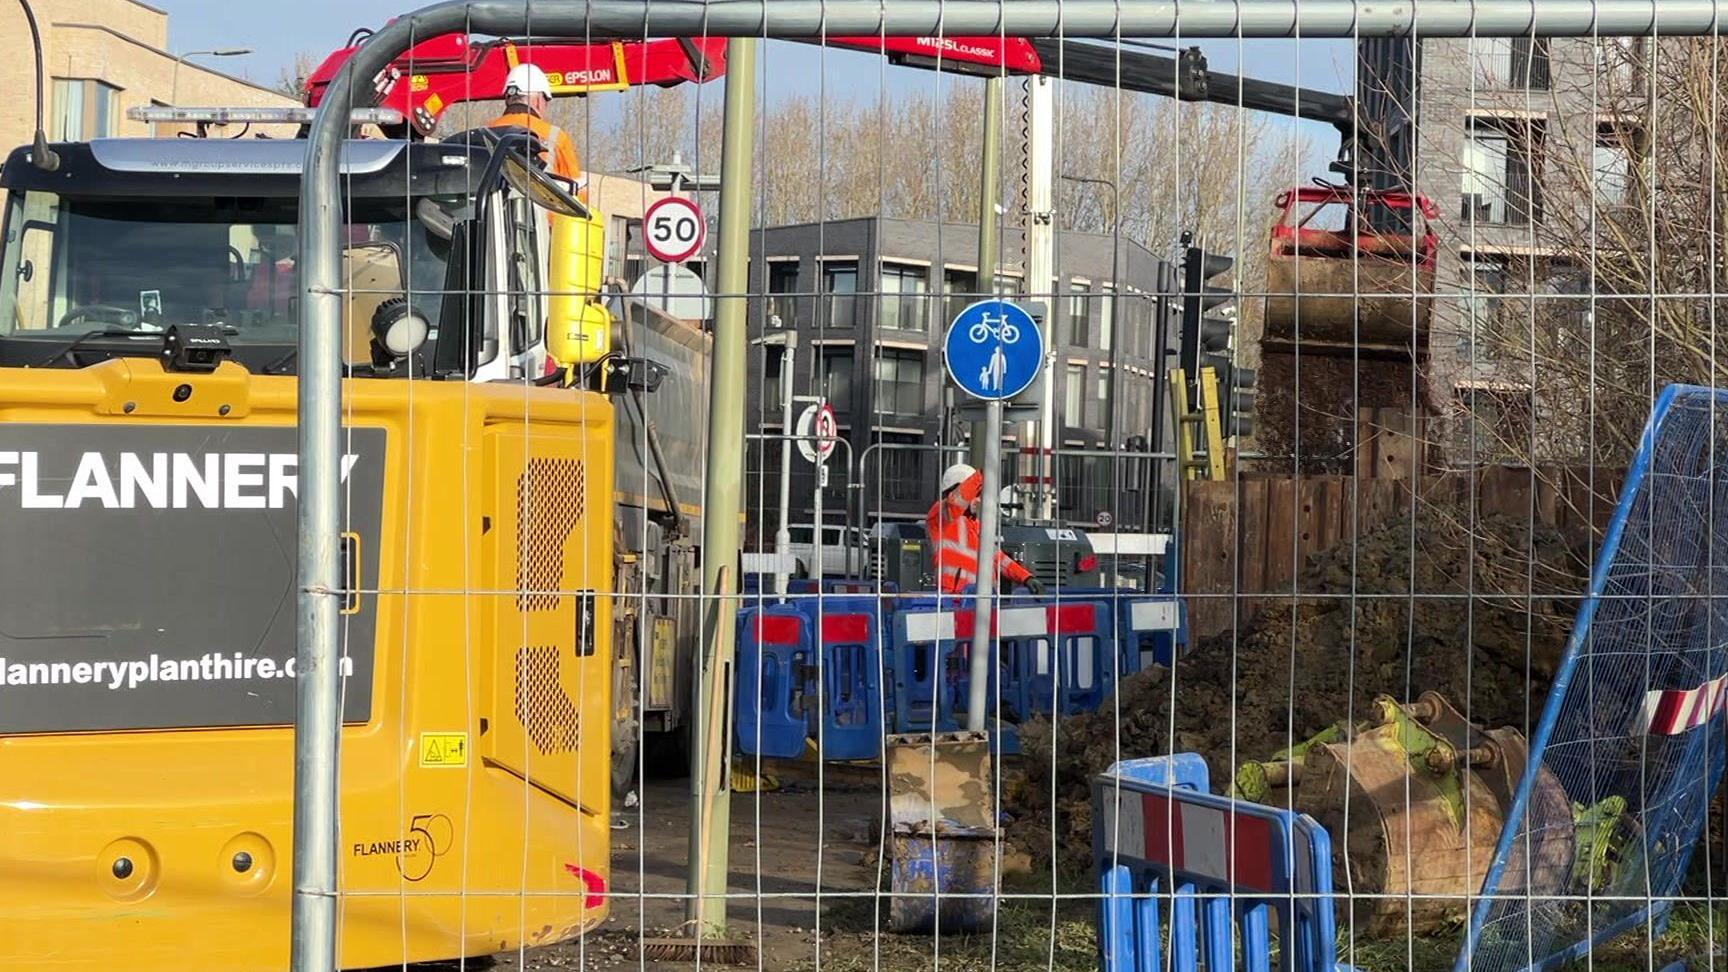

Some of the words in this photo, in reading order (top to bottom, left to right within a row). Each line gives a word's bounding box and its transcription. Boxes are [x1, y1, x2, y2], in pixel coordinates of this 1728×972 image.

[565, 69, 611, 84] EPSILON
[654, 217, 696, 242] 50
[0, 653, 353, 689] lanneryplanthire.c
[353, 839, 420, 857] FLANNERY
[396, 814, 454, 882] 50
